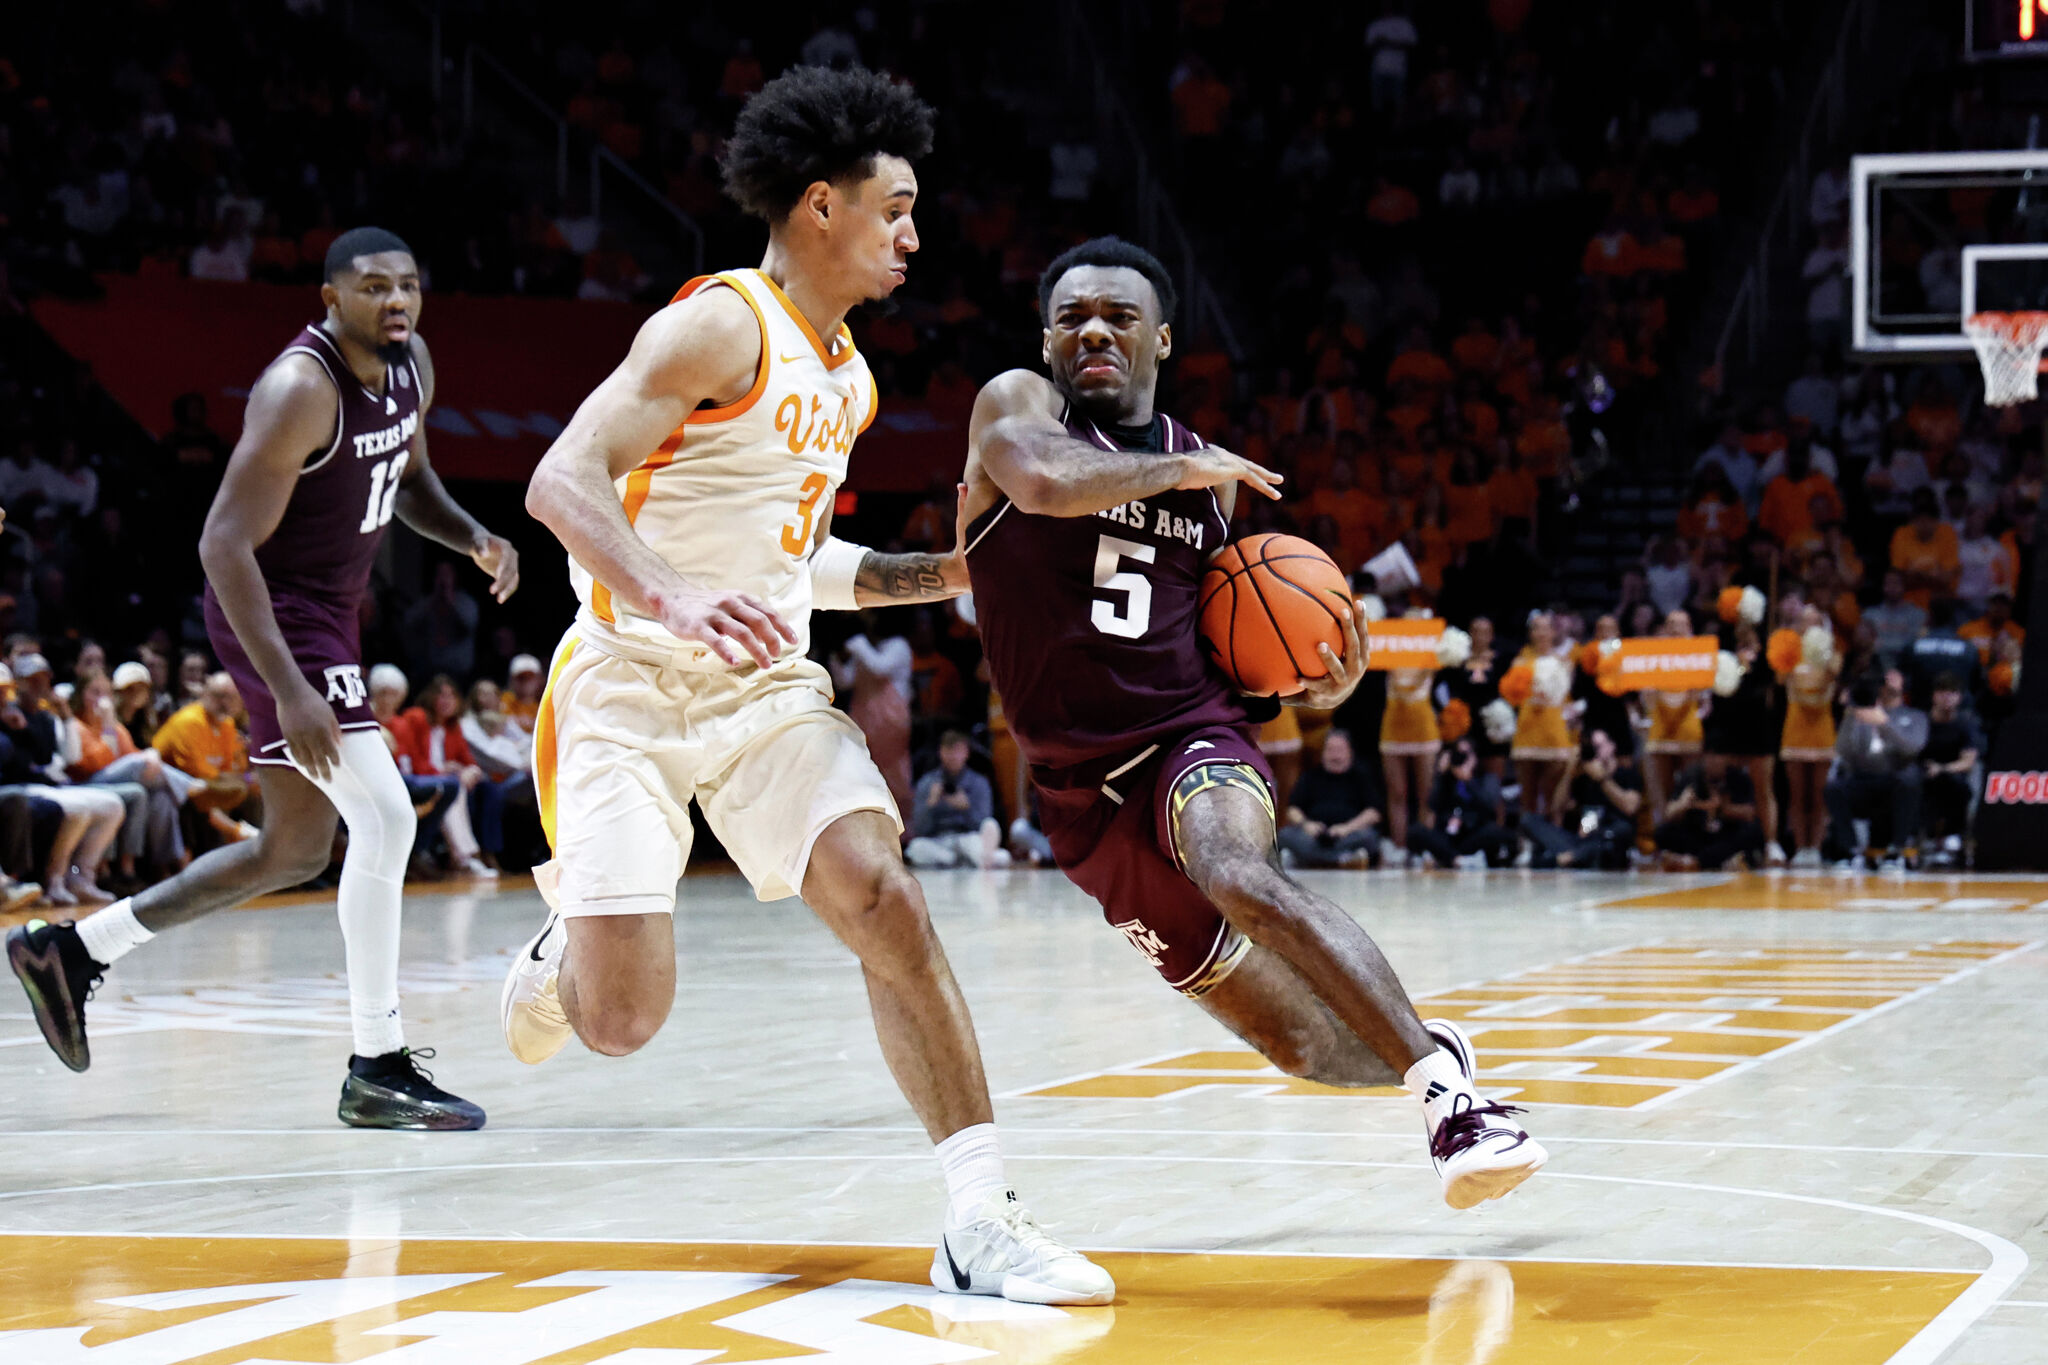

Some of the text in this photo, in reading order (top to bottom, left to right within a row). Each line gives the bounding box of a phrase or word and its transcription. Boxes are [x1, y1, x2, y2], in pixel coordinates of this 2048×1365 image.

[353, 424, 401, 459] TEXAS
[780, 472, 828, 556] 3
[1154, 508, 1204, 550] A&M
[1090, 534, 1156, 639] 5
